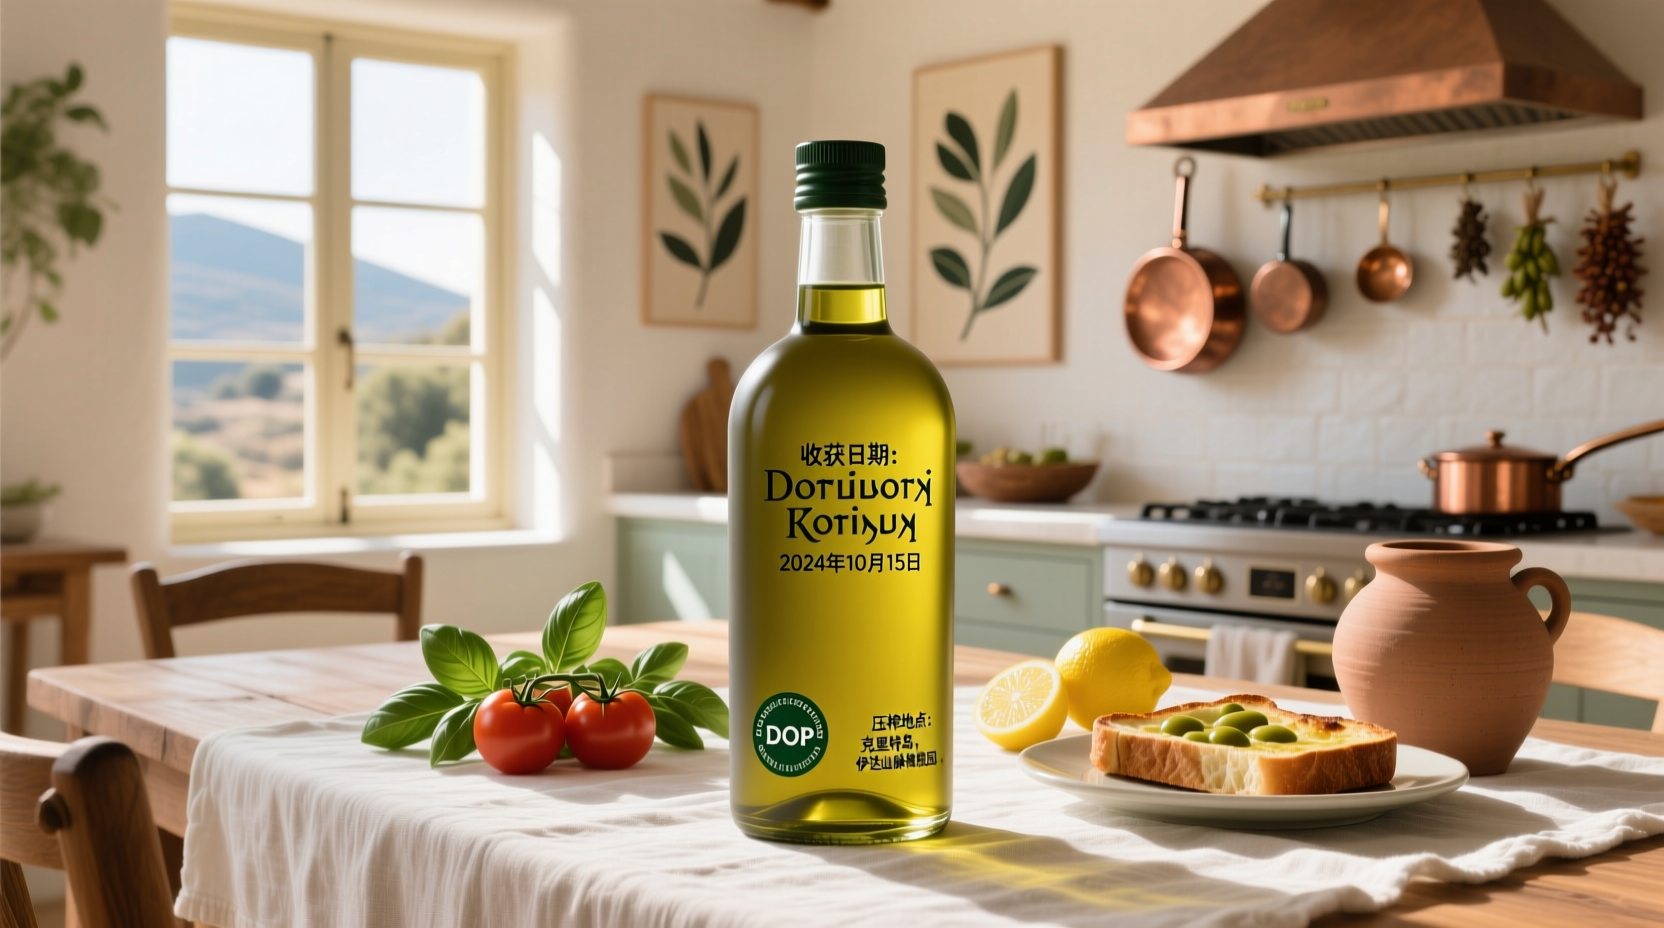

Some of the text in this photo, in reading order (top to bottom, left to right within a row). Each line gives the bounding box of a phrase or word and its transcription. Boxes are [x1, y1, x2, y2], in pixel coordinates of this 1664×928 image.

[800, 442, 897, 467] 收获日期:
[779, 552, 920, 573] 2024年10月15日
[766, 725, 815, 747] DOP
